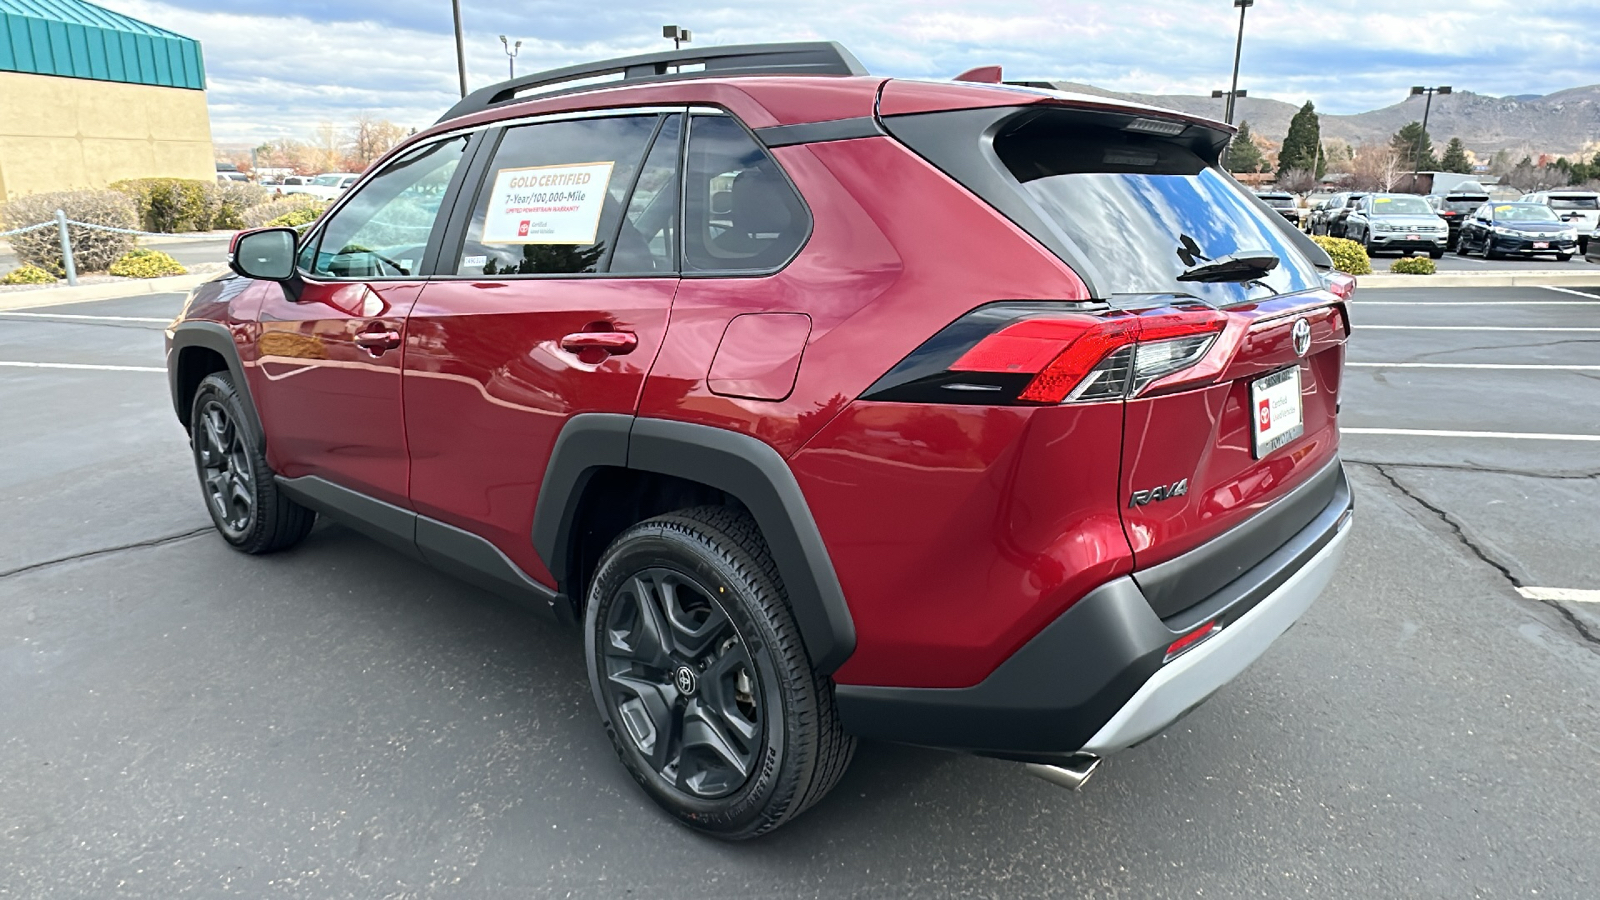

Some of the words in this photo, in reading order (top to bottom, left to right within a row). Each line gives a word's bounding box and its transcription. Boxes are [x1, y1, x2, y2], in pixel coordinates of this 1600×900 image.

[510, 175, 537, 189] GOLD
[538, 172, 591, 187] CERTIFIED
[505, 190, 587, 205] 7-Year/100,000-Mile
[523, 206, 552, 214] POWERTRAIN
[552, 205, 580, 213] WARRANTY
[1272, 395, 1287, 409] Certified
[1270, 430, 1292, 450] TOYOTA
[1128, 478, 1188, 508] RAV4
